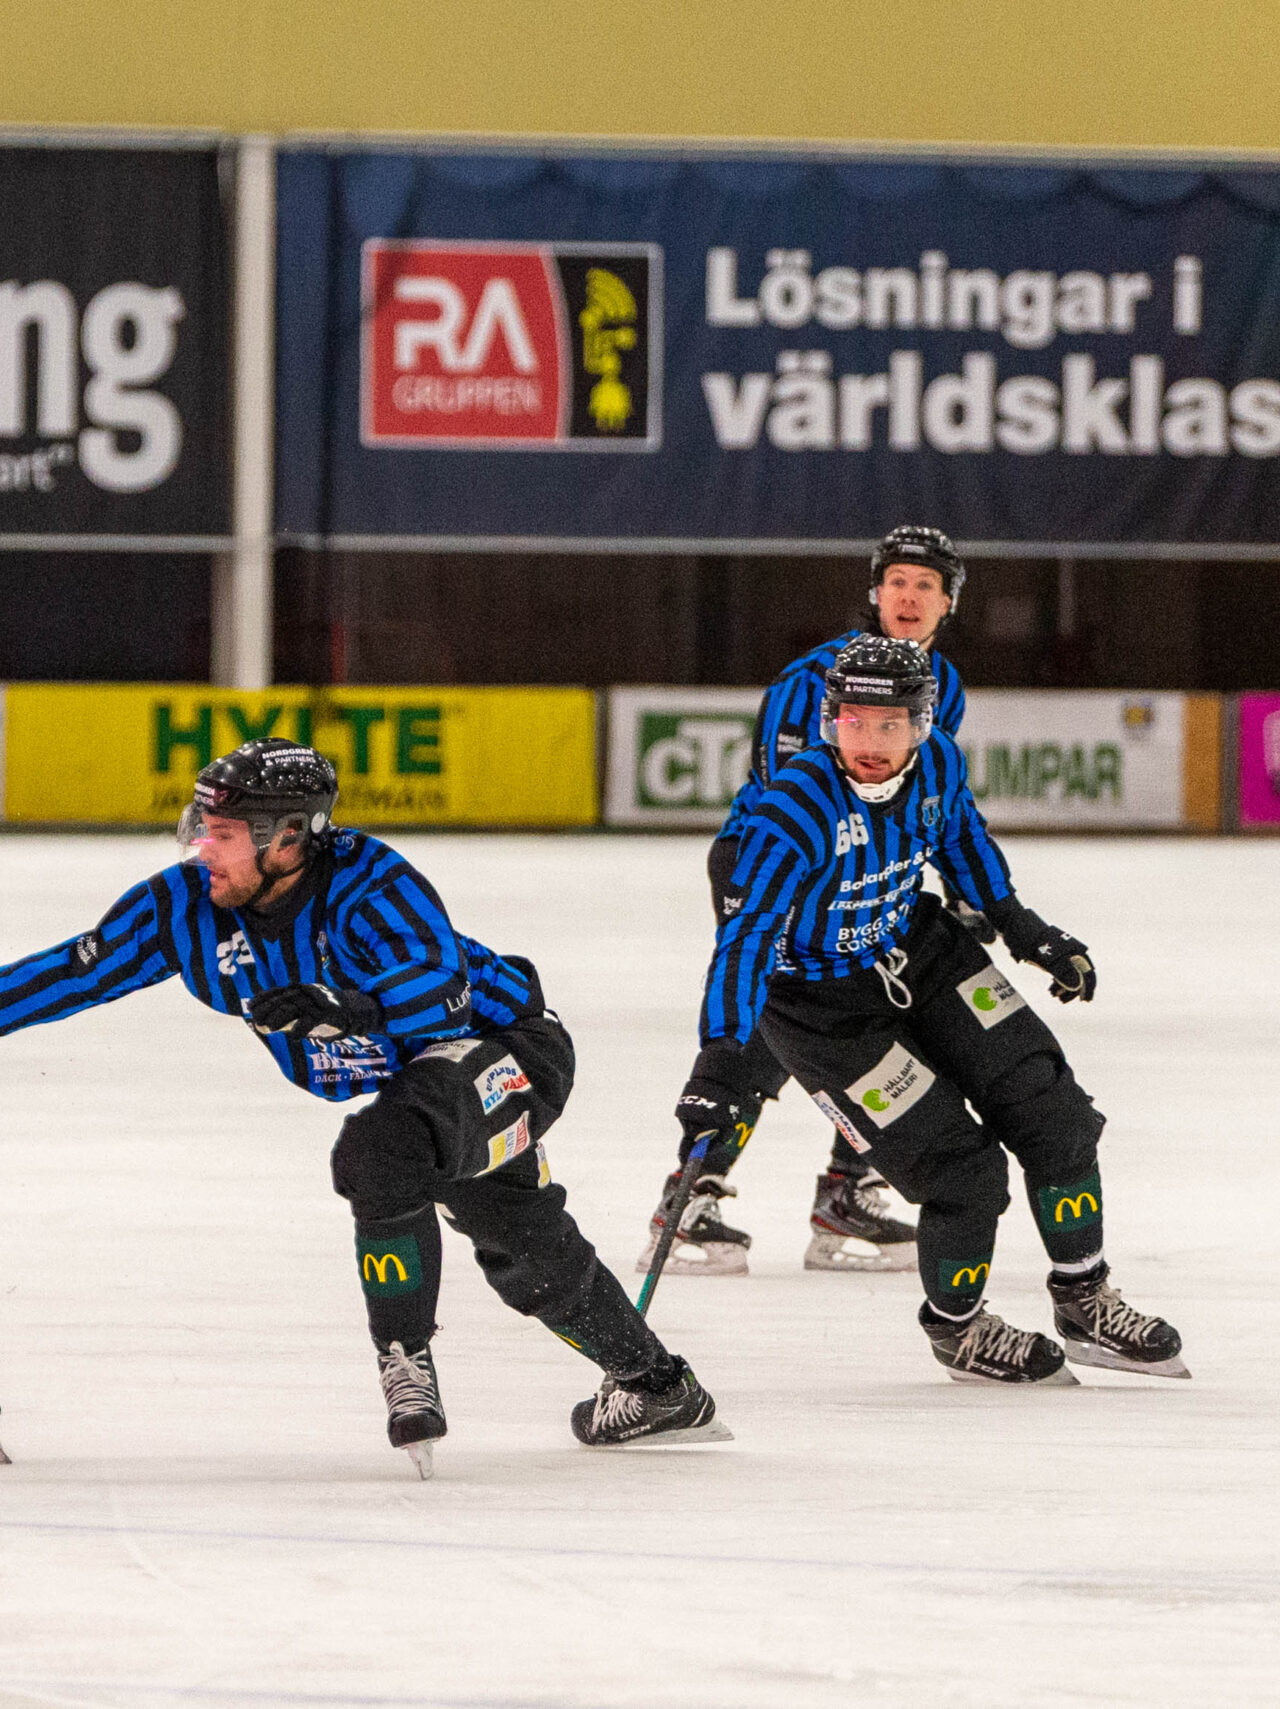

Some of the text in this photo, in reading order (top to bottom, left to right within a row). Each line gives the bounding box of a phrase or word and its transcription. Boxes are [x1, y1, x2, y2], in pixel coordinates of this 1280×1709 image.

[705, 247, 1203, 348] Lösningar i
[393, 275, 538, 372] RA
[392, 374, 541, 416] GRUPPEN
[704, 350, 1280, 457] världsklas
[845, 676, 894, 687] NORDGREN
[853, 686, 893, 695] PARTNERS
[262, 747, 314, 759] NORDGREN
[275, 756, 316, 765] PARTNERS
[835, 813, 870, 856] 66
[840, 859, 912, 893] Bolander
[838, 917, 883, 941] BYGG
[883, 1058, 915, 1093] HÅLLBART
[890, 1073, 918, 1100] MÅLERI
